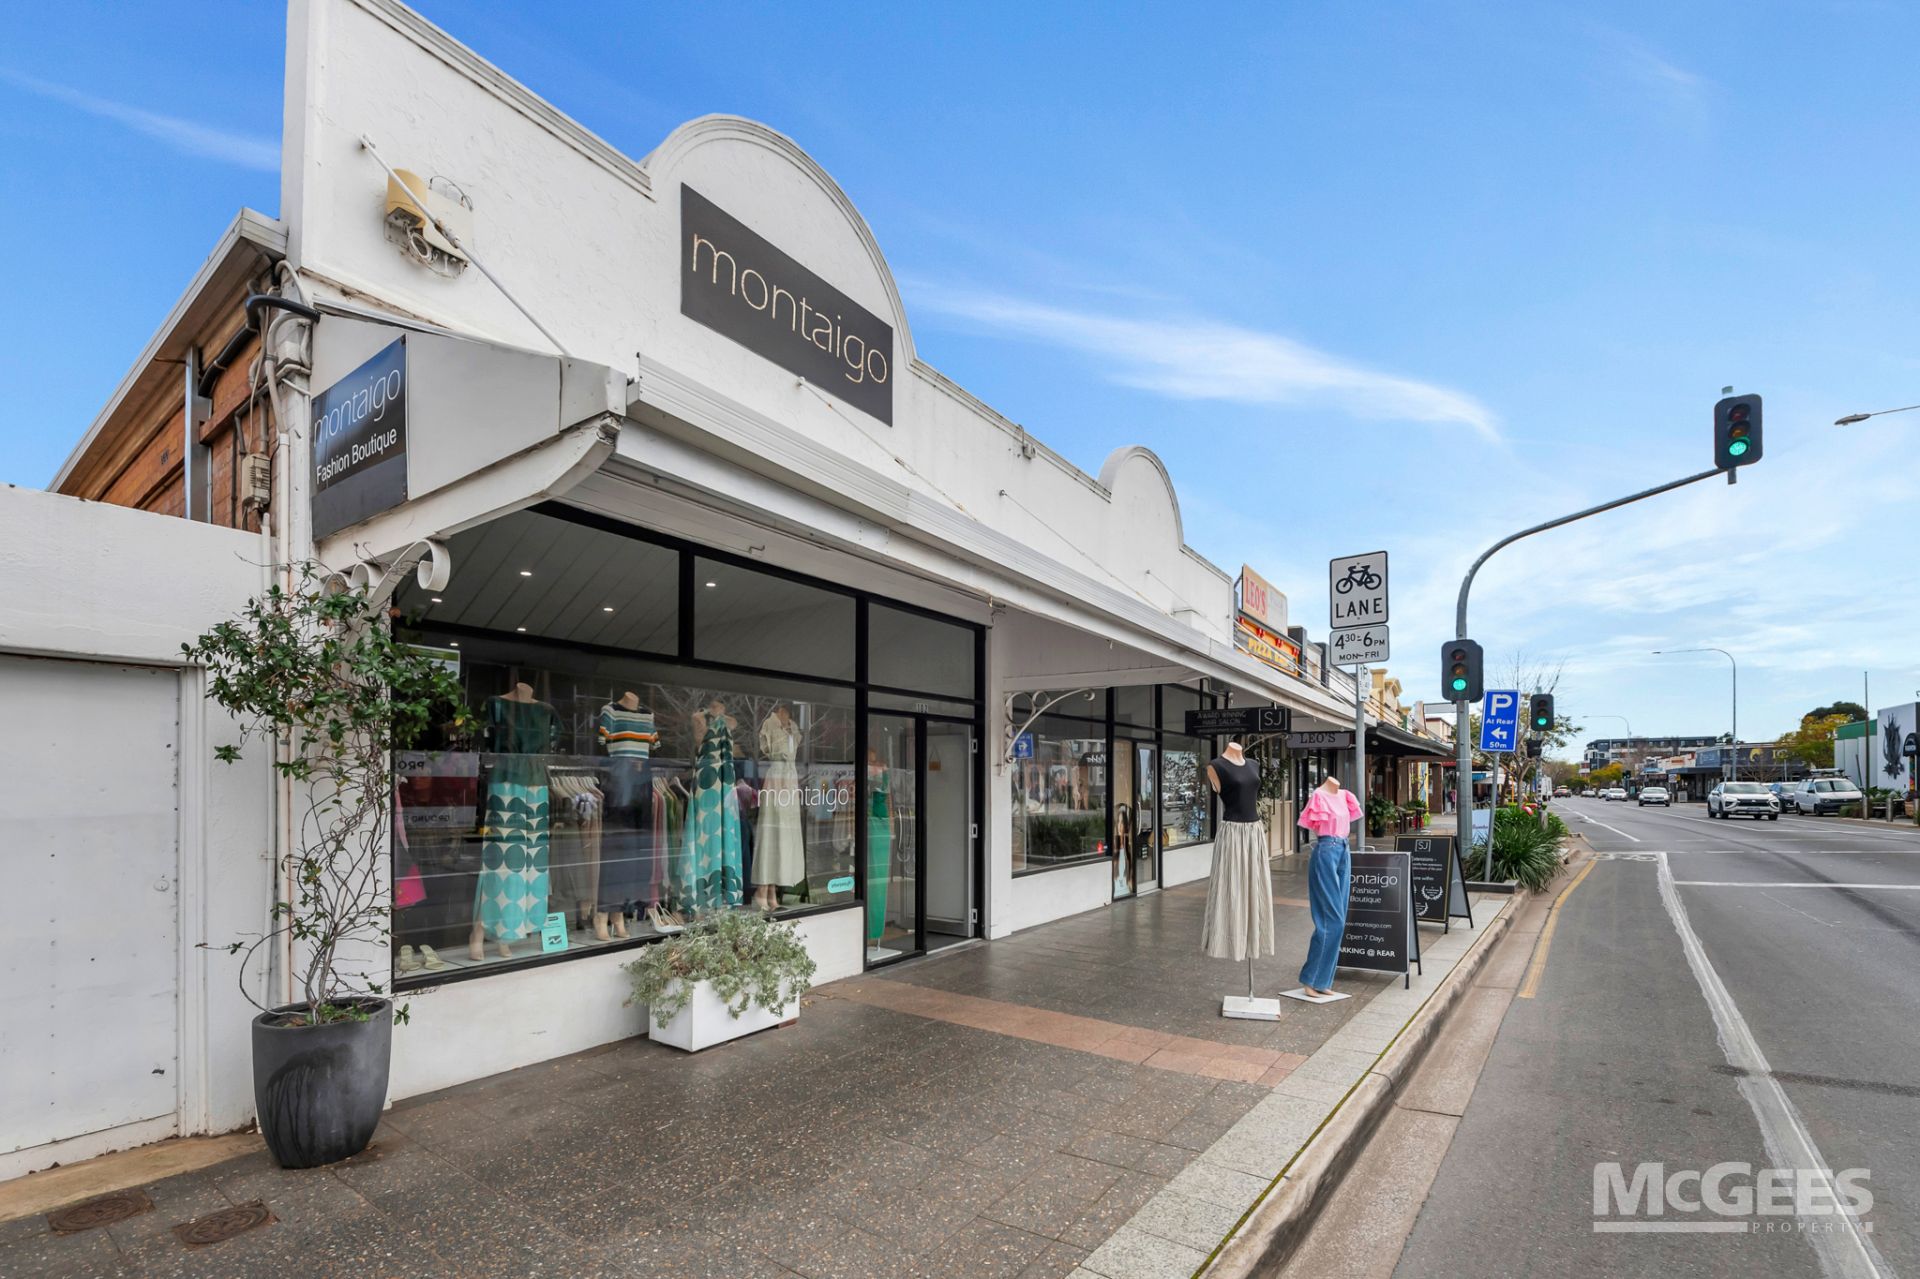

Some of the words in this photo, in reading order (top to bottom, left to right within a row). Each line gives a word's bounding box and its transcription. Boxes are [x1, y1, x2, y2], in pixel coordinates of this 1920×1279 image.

[692, 232, 888, 385] montaigo
[313, 369, 401, 447] montaigo
[316, 454, 350, 485] Fashion
[352, 428, 398, 465] Boutique
[1246, 577, 1266, 616] LEO'S
[1336, 598, 1383, 619] LANE
[1490, 694, 1513, 716] P
[1264, 711, 1282, 727] SJ
[1300, 732, 1336, 744] LEO'S
[1489, 741, 1507, 749] 50m
[757, 784, 849, 812] montaigo
[1418, 841, 1429, 850] SJ
[1350, 873, 1398, 888] ontaigo
[1352, 886, 1380, 895] Fashion
[1350, 896, 1382, 905] Boutique
[1346, 934, 1363, 942] Open
[1369, 935, 1385, 943] Days
[1340, 947, 1366, 955] ARKING
[1366, 949, 1375, 957] @
[1376, 949, 1395, 957] REAR
